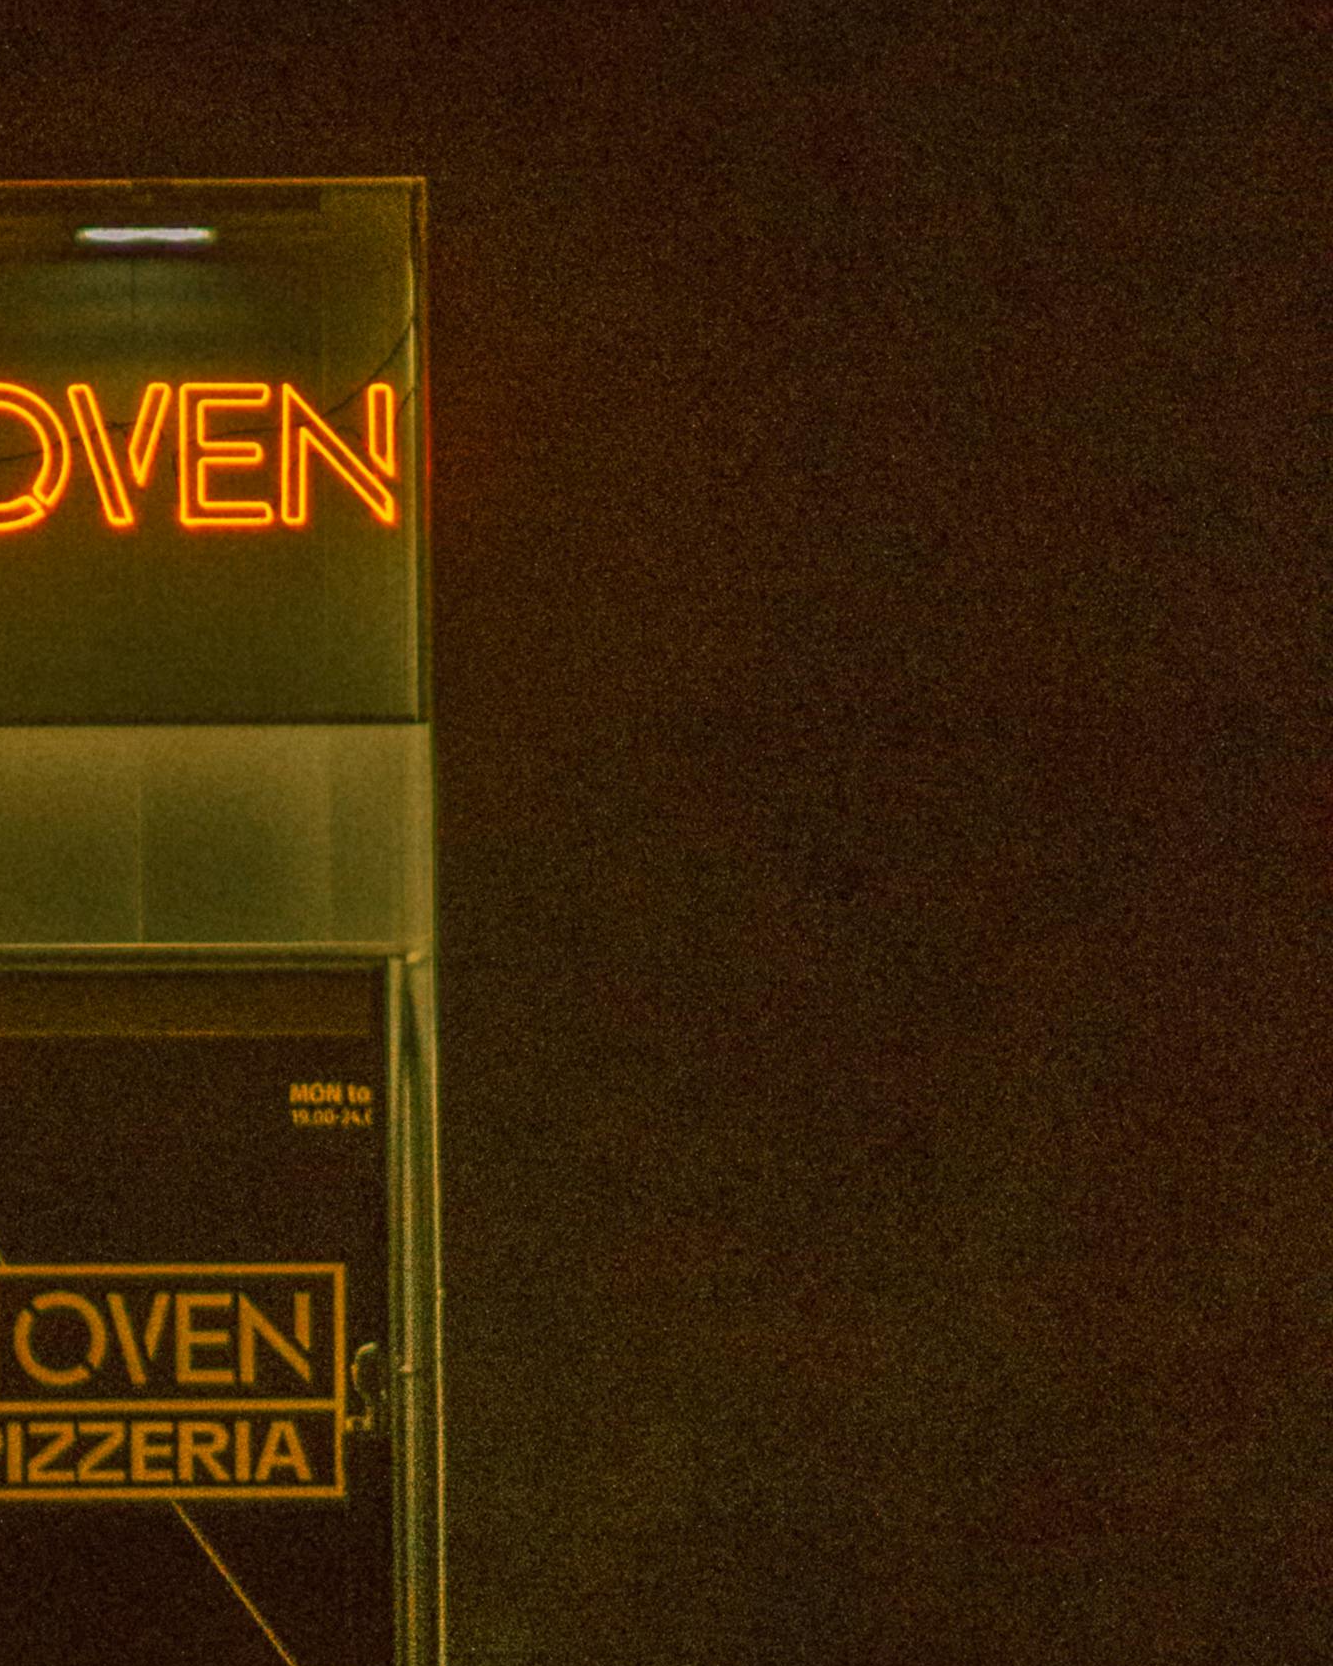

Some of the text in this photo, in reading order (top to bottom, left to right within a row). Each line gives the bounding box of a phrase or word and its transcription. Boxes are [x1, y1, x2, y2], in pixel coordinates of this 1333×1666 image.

[289, 1081, 372, 1104] MON to
[14, 1292, 312, 1386] OVEN
